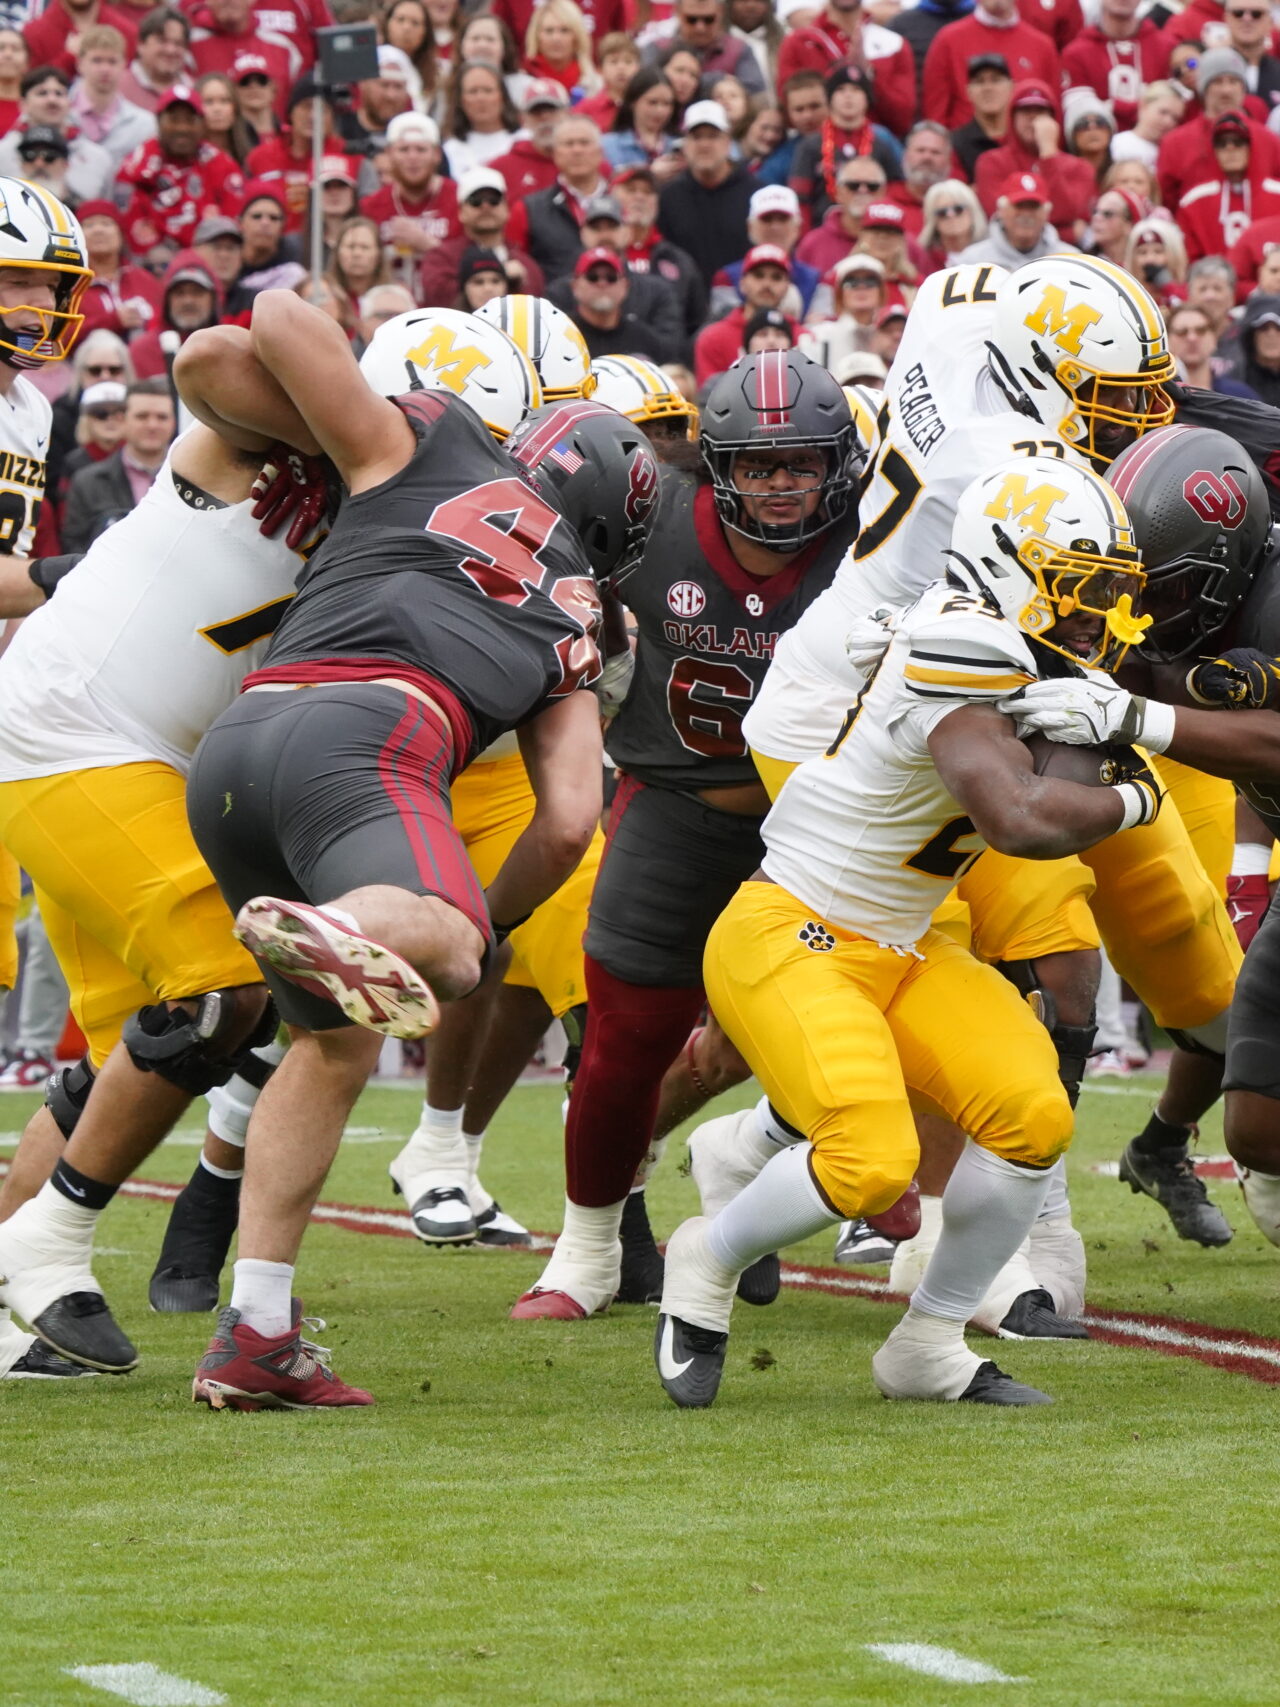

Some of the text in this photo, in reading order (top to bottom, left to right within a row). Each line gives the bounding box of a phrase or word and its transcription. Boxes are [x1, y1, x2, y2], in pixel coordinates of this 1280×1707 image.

[1023, 283, 1104, 357] M
[404, 324, 493, 396] M
[898, 361, 947, 458] PEAGLER
[983, 472, 1070, 537] M
[1183, 469, 1248, 531] OU
[668, 581, 705, 618] SEC
[745, 593, 764, 617] OU
[667, 655, 754, 758] 6
